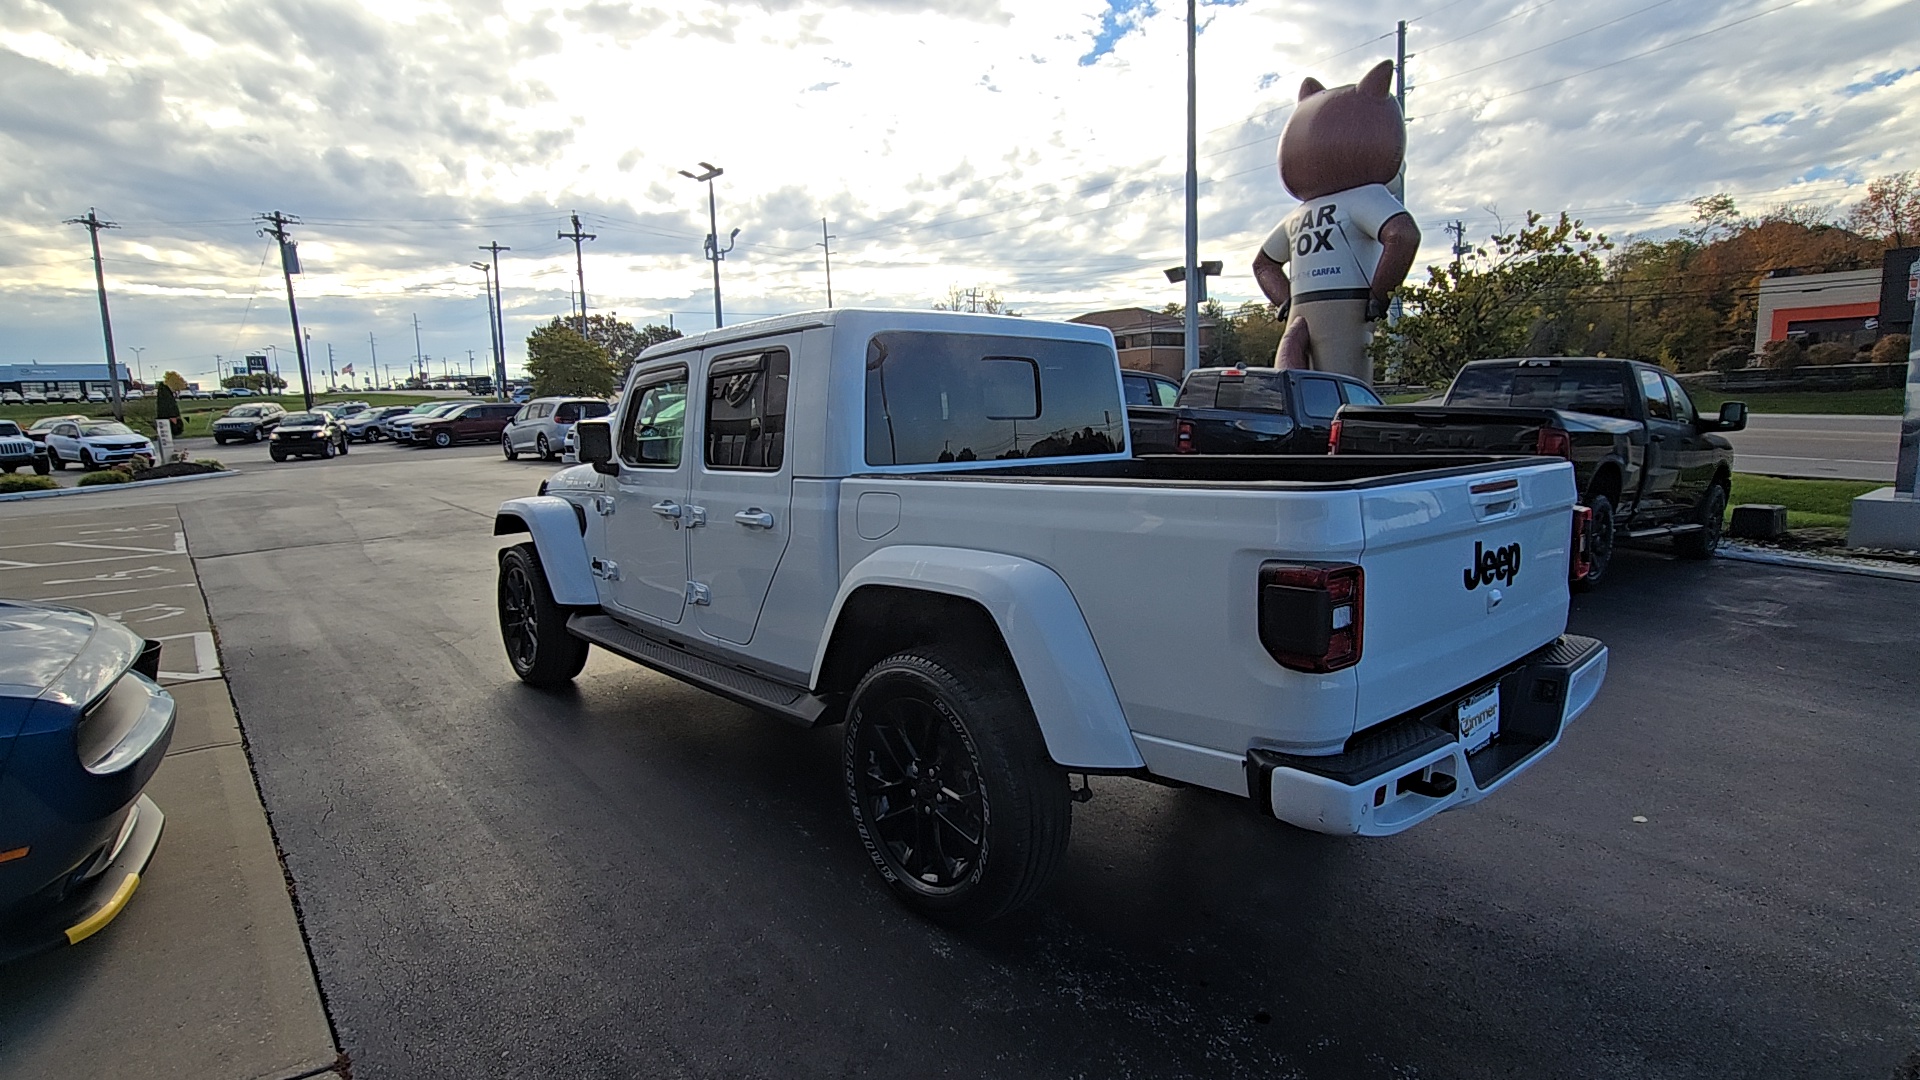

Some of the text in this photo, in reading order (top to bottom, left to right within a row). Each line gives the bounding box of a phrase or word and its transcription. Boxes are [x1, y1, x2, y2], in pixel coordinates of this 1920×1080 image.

[1289, 204, 1337, 237] CAR
[1290, 228, 1335, 256] FOX
[1312, 266, 1341, 277] CARFAX
[1378, 430, 1476, 449] RAM
[1463, 541, 1522, 591] Jeep
